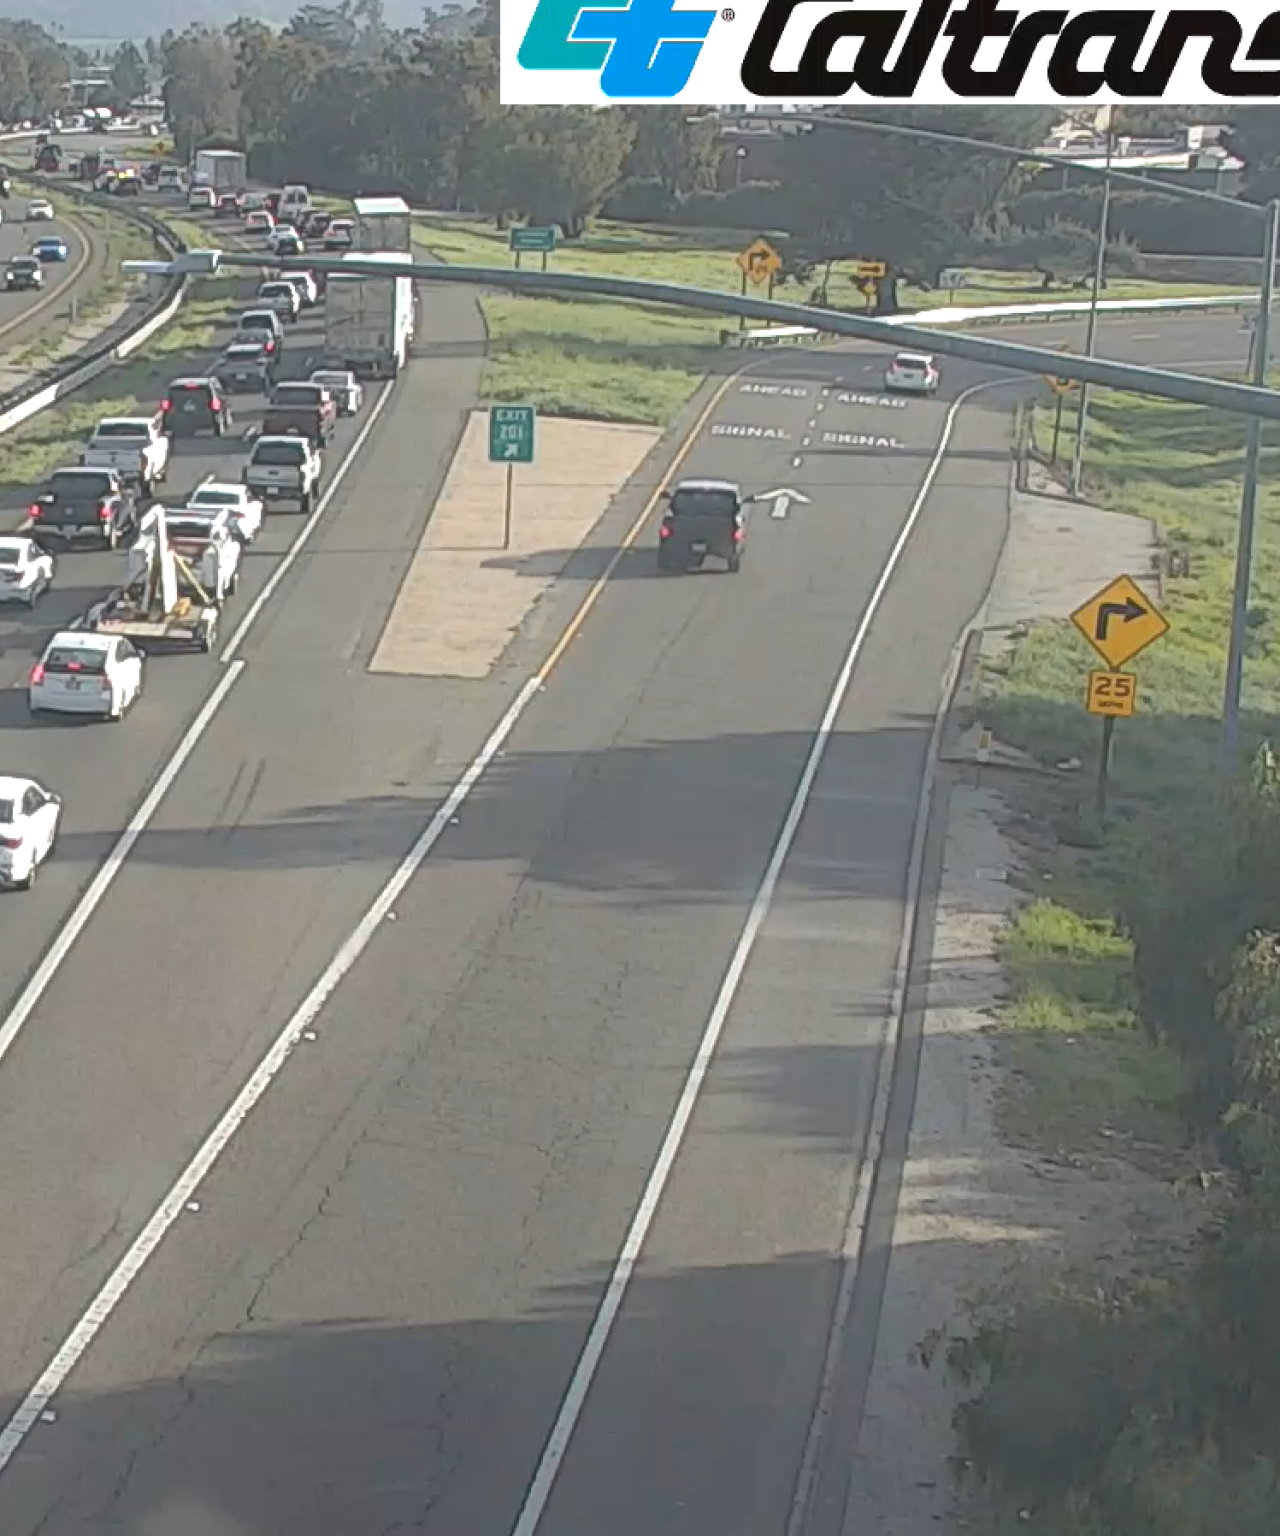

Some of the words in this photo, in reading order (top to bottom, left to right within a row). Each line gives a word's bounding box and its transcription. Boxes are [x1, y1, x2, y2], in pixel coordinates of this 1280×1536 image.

[739, 384, 808, 397] AHEAD
[837, 393, 906, 408] AHEAD
[496, 409, 528, 421] EXIT
[1094, 676, 1131, 697] 25
